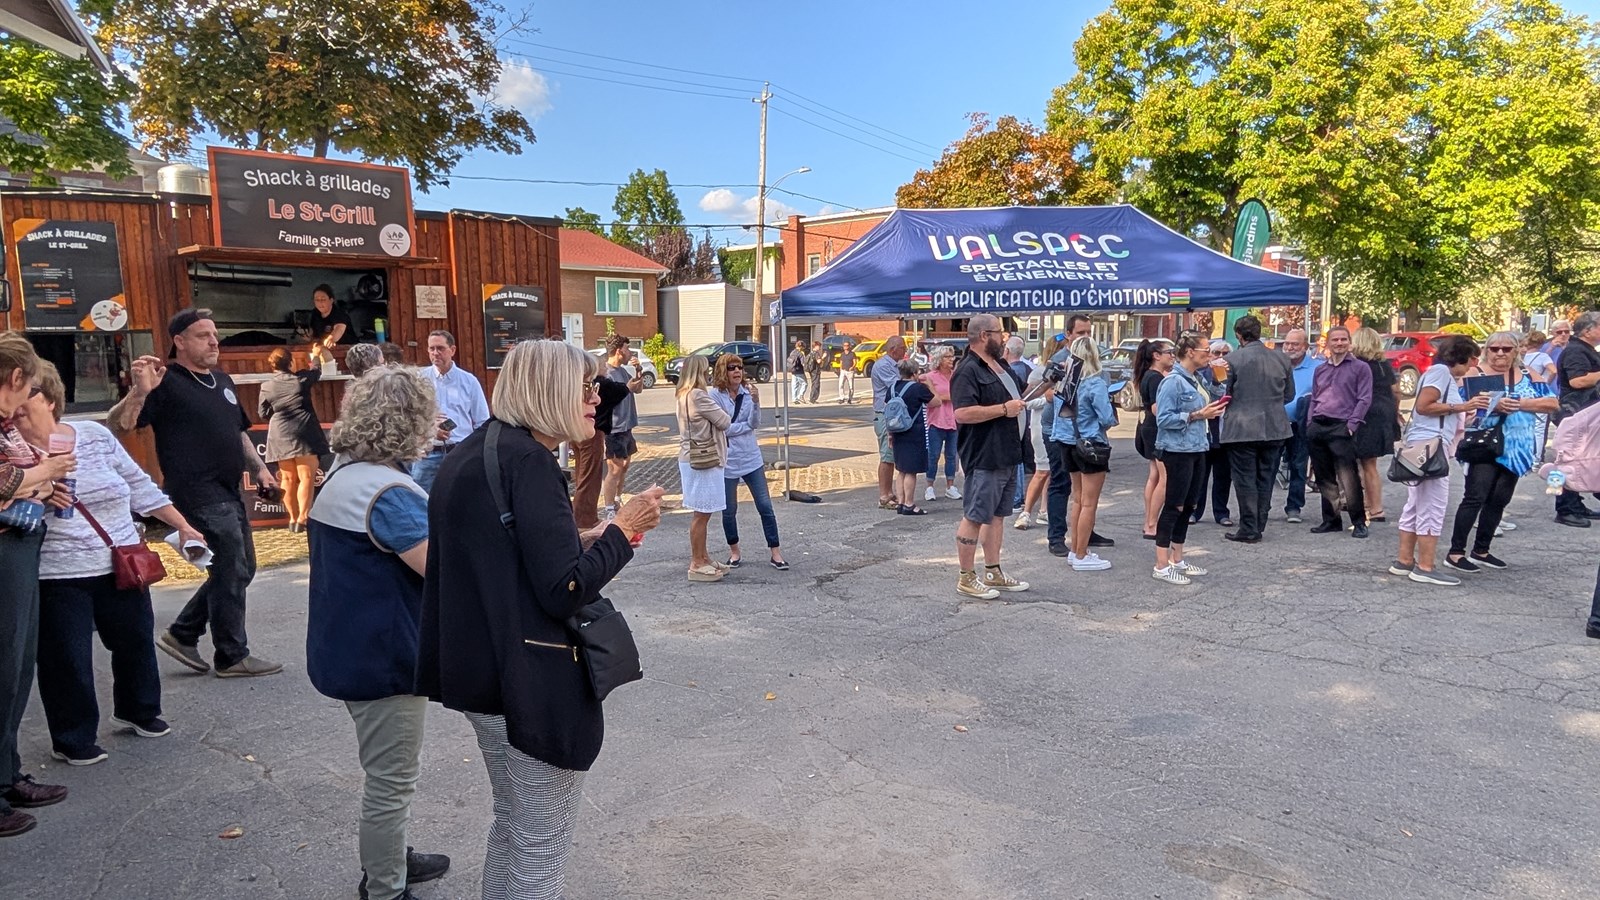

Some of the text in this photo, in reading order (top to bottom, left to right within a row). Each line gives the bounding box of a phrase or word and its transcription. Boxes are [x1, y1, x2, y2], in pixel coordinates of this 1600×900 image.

[243, 169, 391, 200] Shack à grillades
[268, 198, 377, 226] Le St-Grill
[27, 230, 53, 241] SHACK
[63, 230, 107, 243] GRILLADES
[278, 230, 365, 248] Famille St-Pierre
[928, 231, 1130, 261] VALSPEC
[959, 260, 1119, 273] SPECTACLES ET
[973, 269, 1119, 282] ÉVÉNEMENTS
[933, 283, 1169, 309] AMPLIFICATEUR D'ÉMOTIONS
[254, 501, 288, 513] Famil
